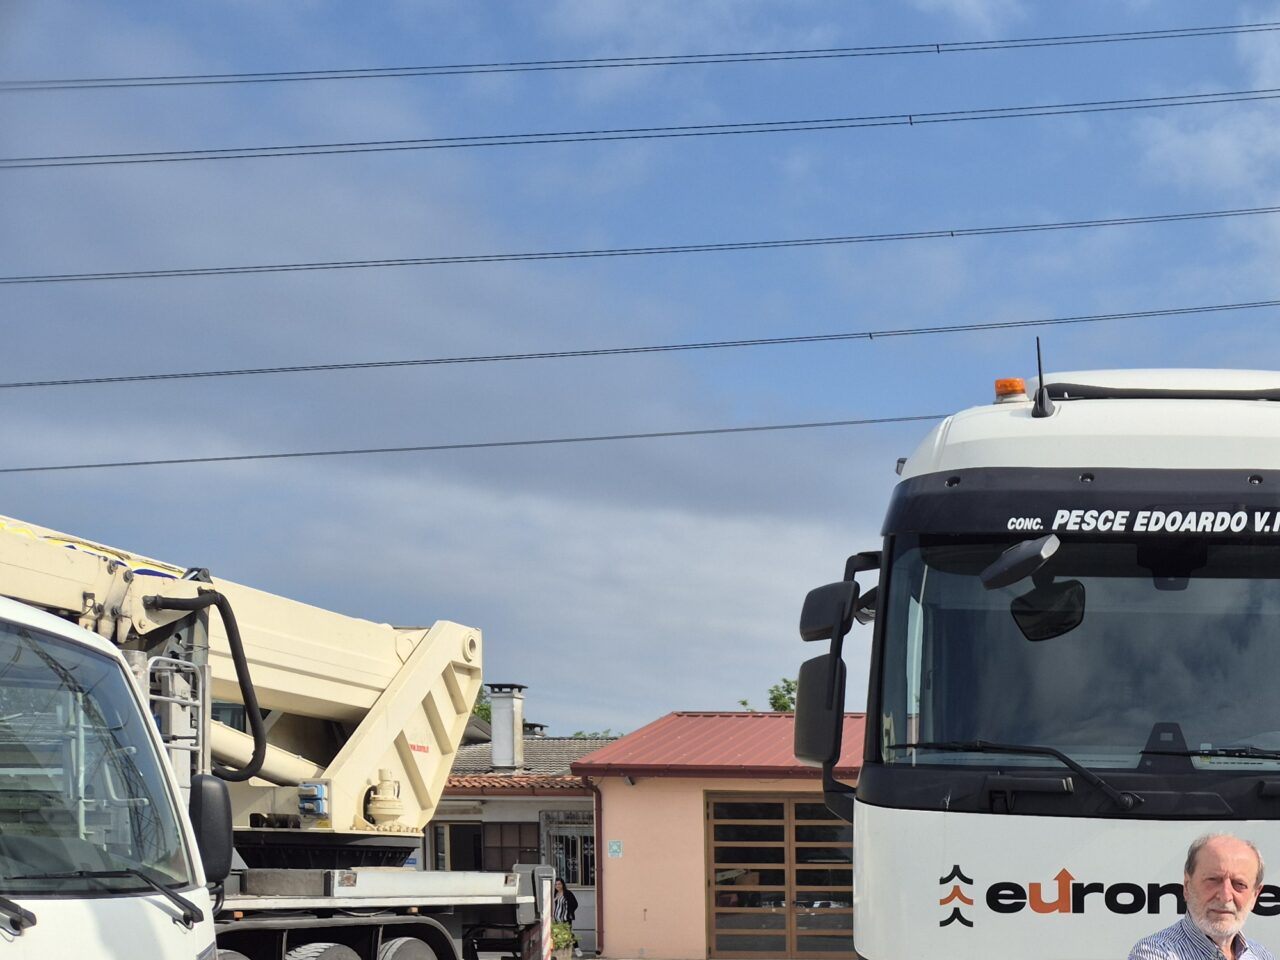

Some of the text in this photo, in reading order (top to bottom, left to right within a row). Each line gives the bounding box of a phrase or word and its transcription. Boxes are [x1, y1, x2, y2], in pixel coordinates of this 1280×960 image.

[1007, 517, 1044, 530] CONC.
[1052, 509, 1130, 531] PESCE
[1132, 511, 1248, 532] EDOARDO
